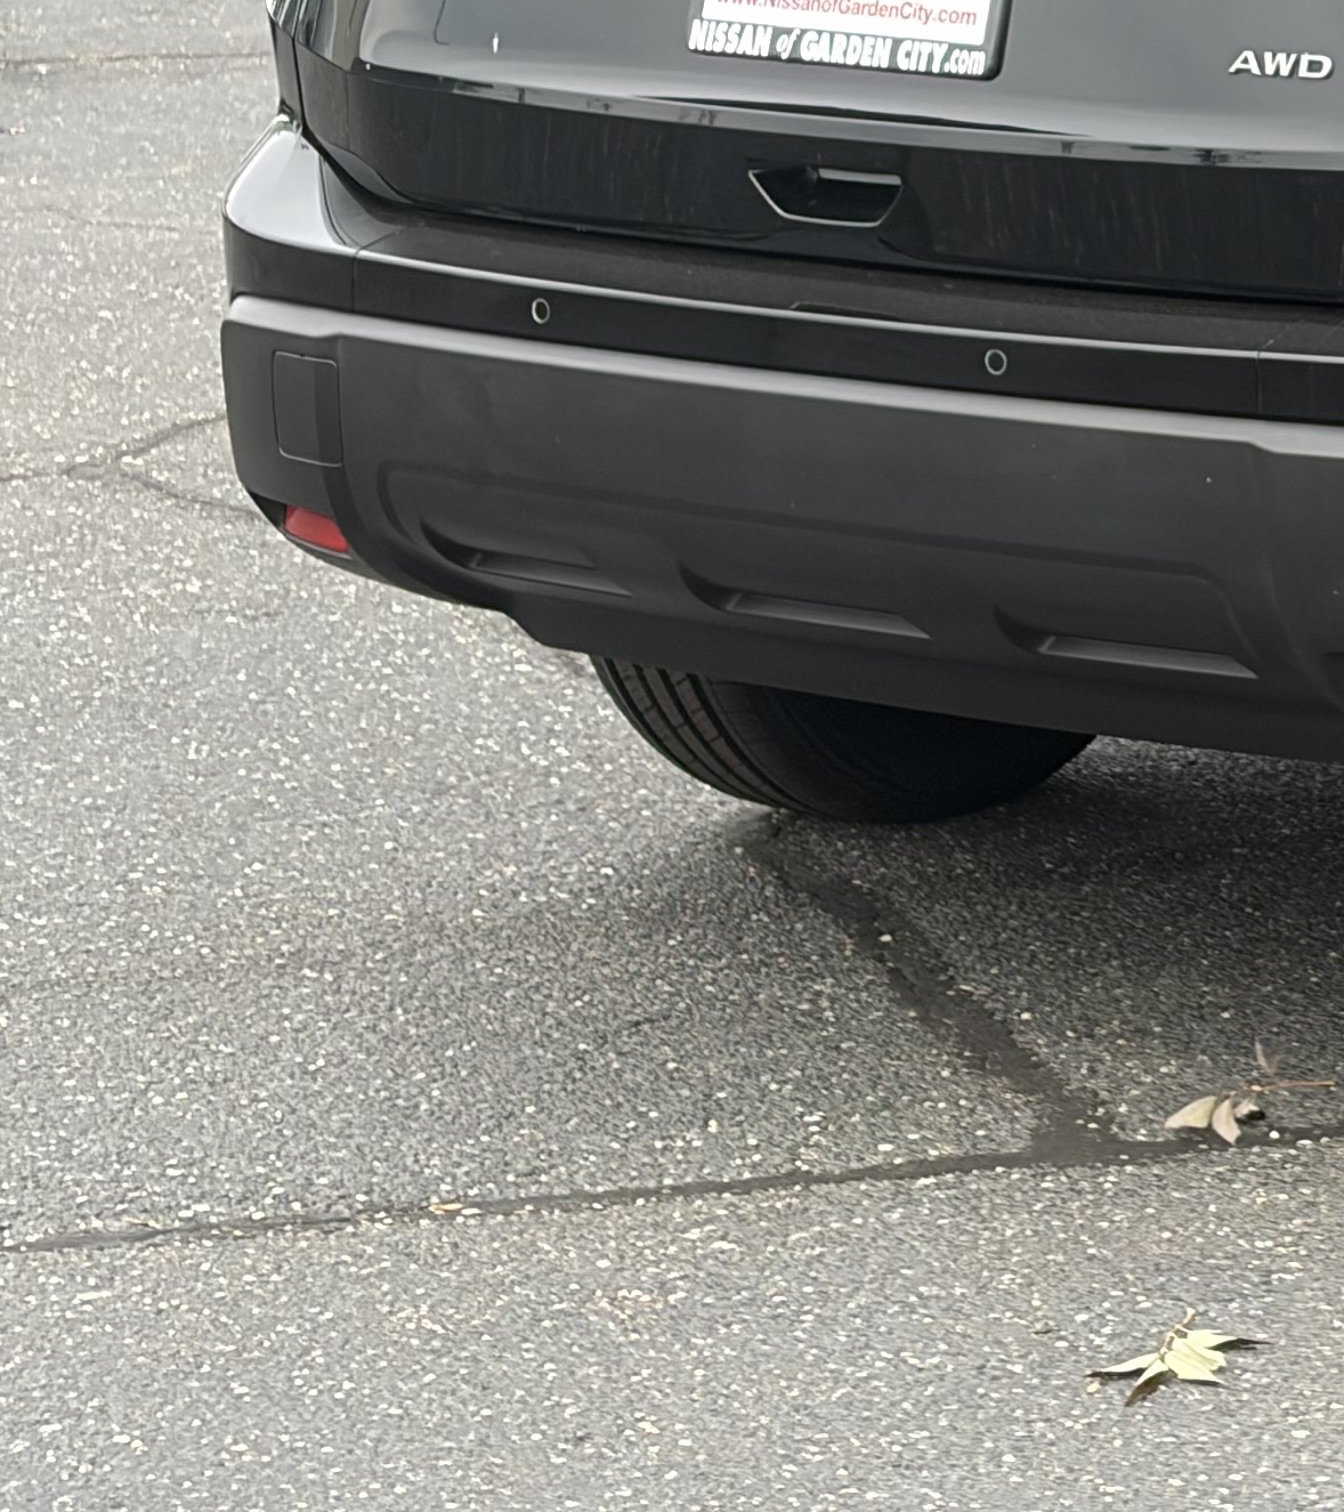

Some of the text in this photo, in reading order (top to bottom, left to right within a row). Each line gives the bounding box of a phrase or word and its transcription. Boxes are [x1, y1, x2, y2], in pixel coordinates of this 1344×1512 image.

[688, 18, 987, 76] NISSAN of GARDEN CITY.com
[1227, 49, 1333, 80] AWD
